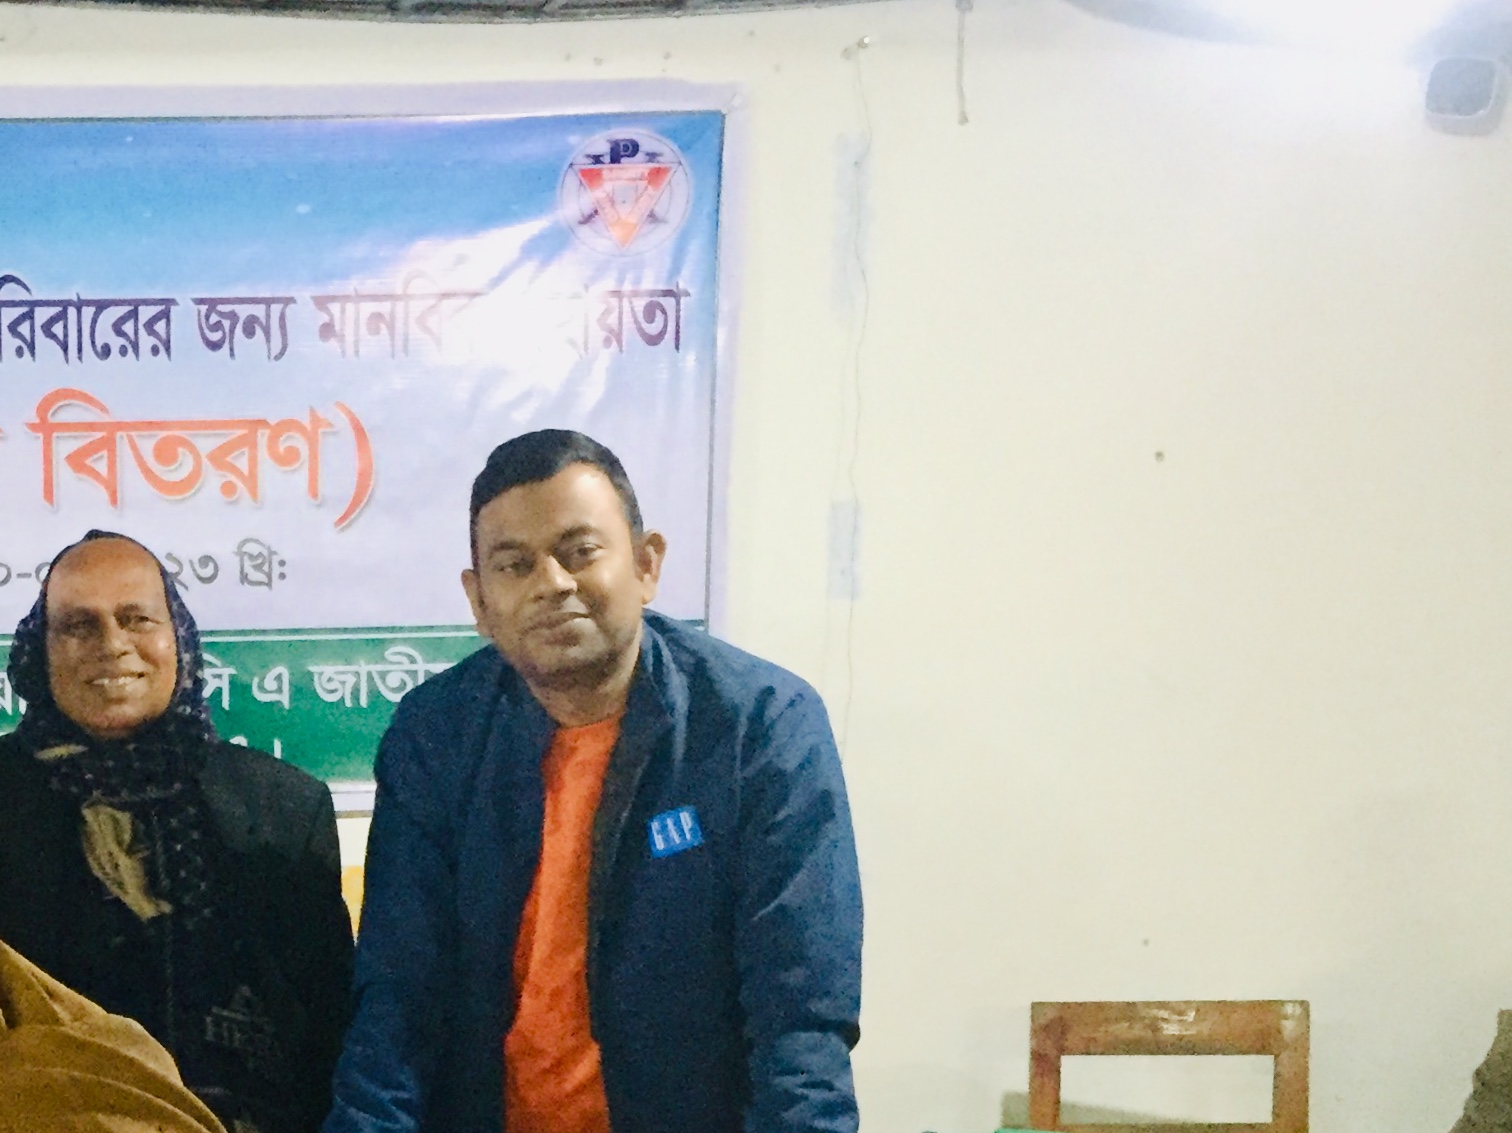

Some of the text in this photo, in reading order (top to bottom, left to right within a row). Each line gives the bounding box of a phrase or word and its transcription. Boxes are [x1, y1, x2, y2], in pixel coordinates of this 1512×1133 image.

[191, 296, 297, 362] জন্য
[26, 387, 375, 529] বিতরণ)
[251, 666, 290, 710] এ
